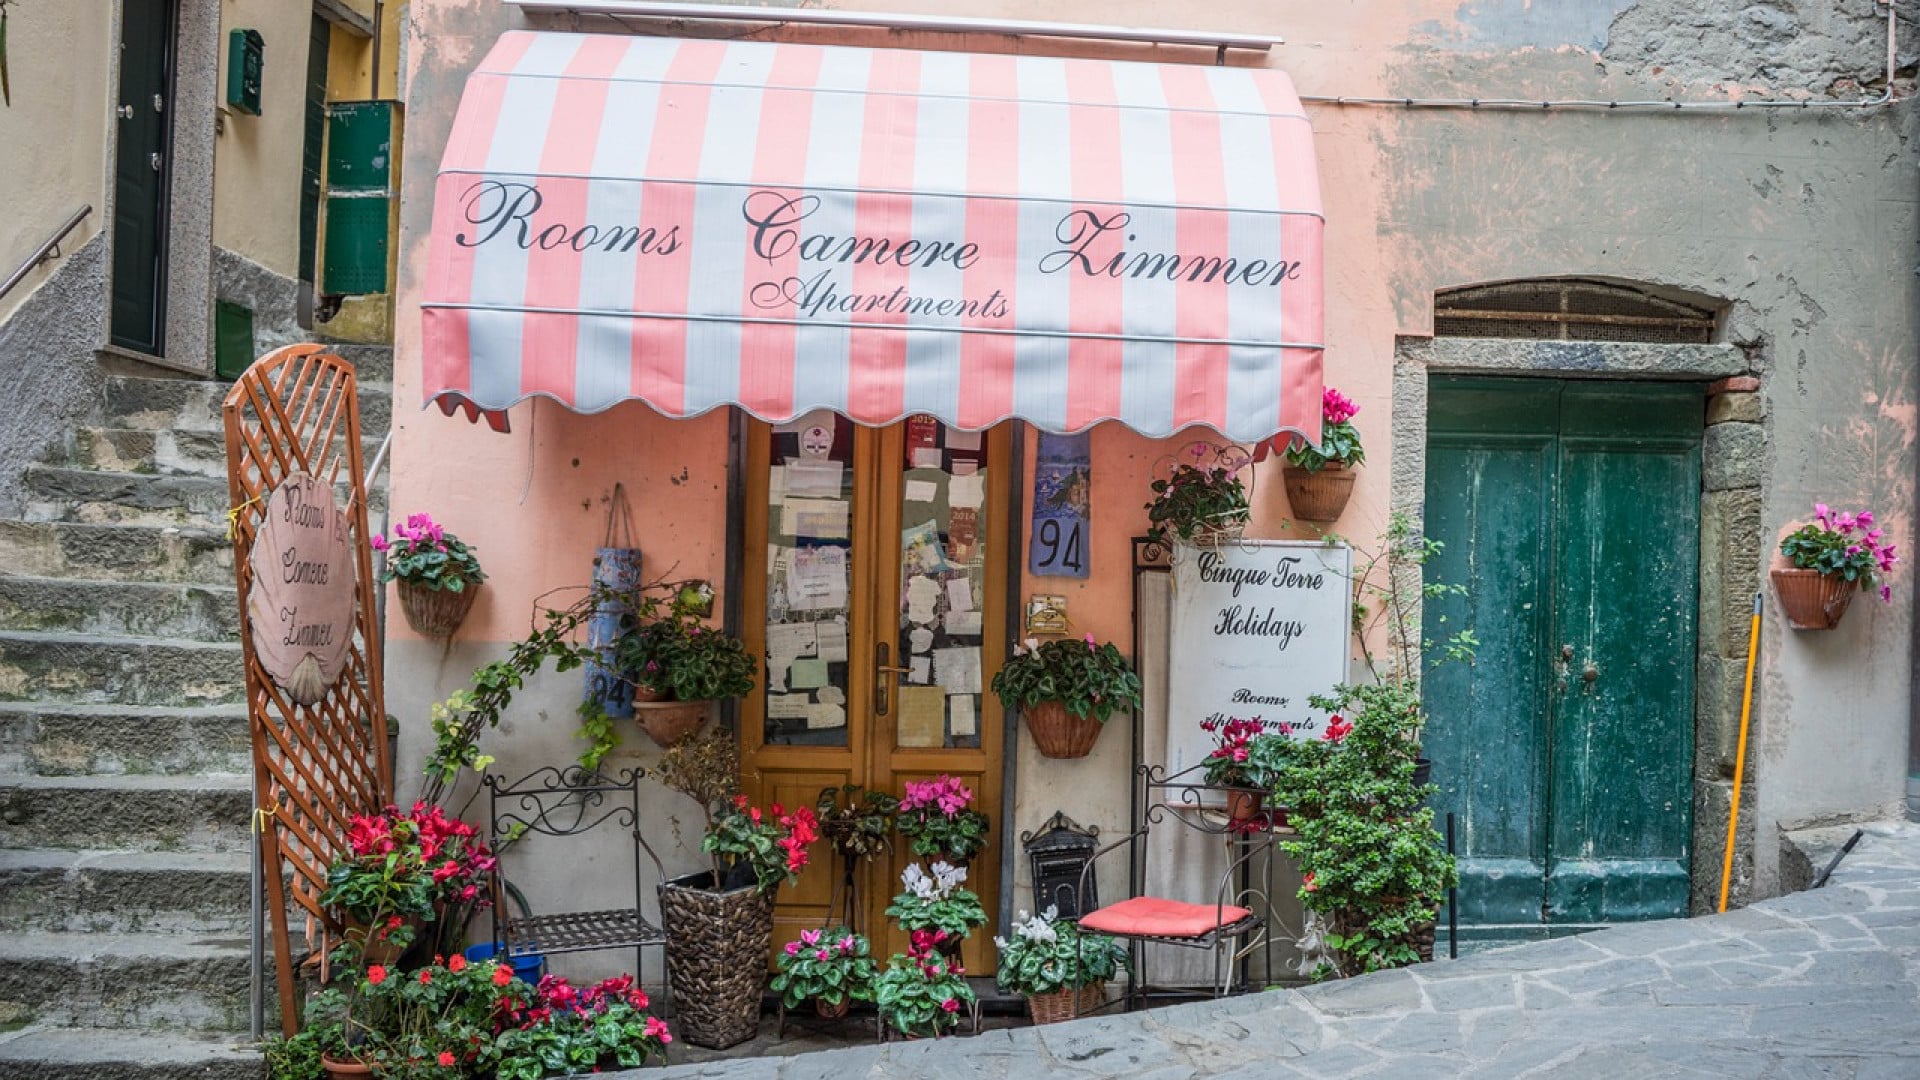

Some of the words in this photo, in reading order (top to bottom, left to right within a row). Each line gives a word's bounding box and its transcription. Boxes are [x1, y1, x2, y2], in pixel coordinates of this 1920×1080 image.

[456, 180, 683, 256] Rooms
[742, 191, 980, 270] Camere
[1038, 209, 1301, 286] Zimmer
[749, 268, 1010, 318] Apartments
[1038, 519, 1081, 573] 94
[1197, 551, 1270, 598] Cinque
[1272, 557, 1324, 589] Terre
[1214, 604, 1307, 651] Holidays
